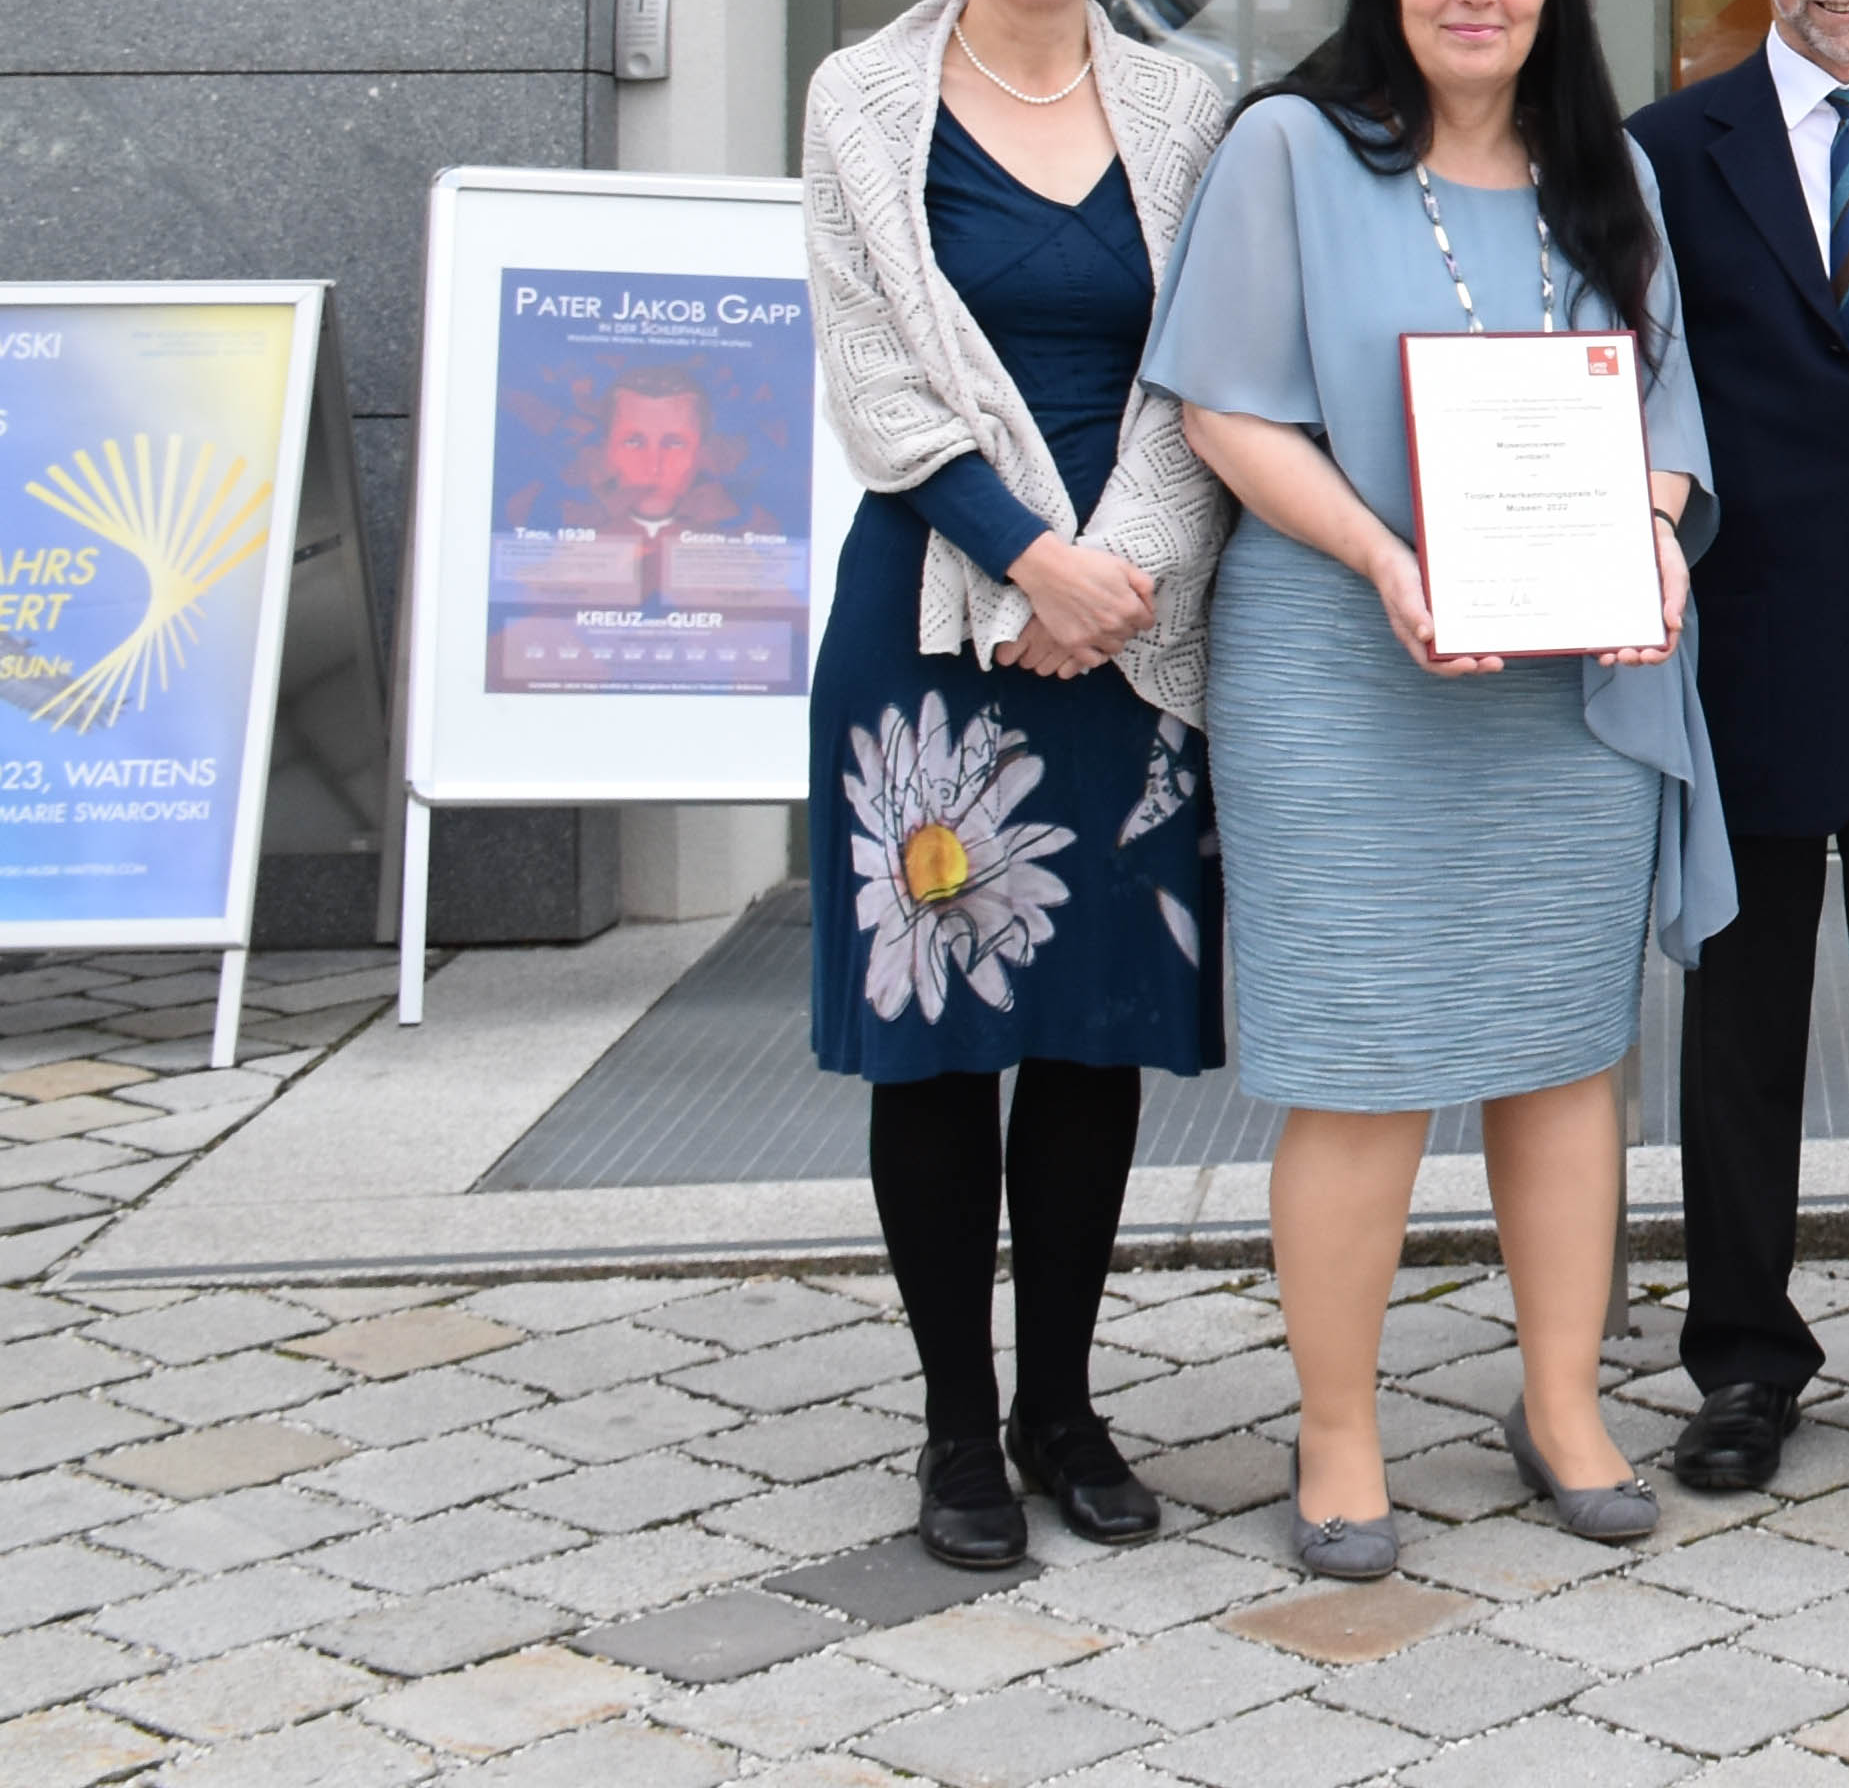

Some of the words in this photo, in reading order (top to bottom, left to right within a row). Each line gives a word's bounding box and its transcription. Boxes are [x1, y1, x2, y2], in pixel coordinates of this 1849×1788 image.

[0, 547, 100, 586] HRS
[0, 760, 51, 794] 23,
[64, 758, 217, 789] WATTENS
[73, 800, 212, 823] SWAROVSKI
